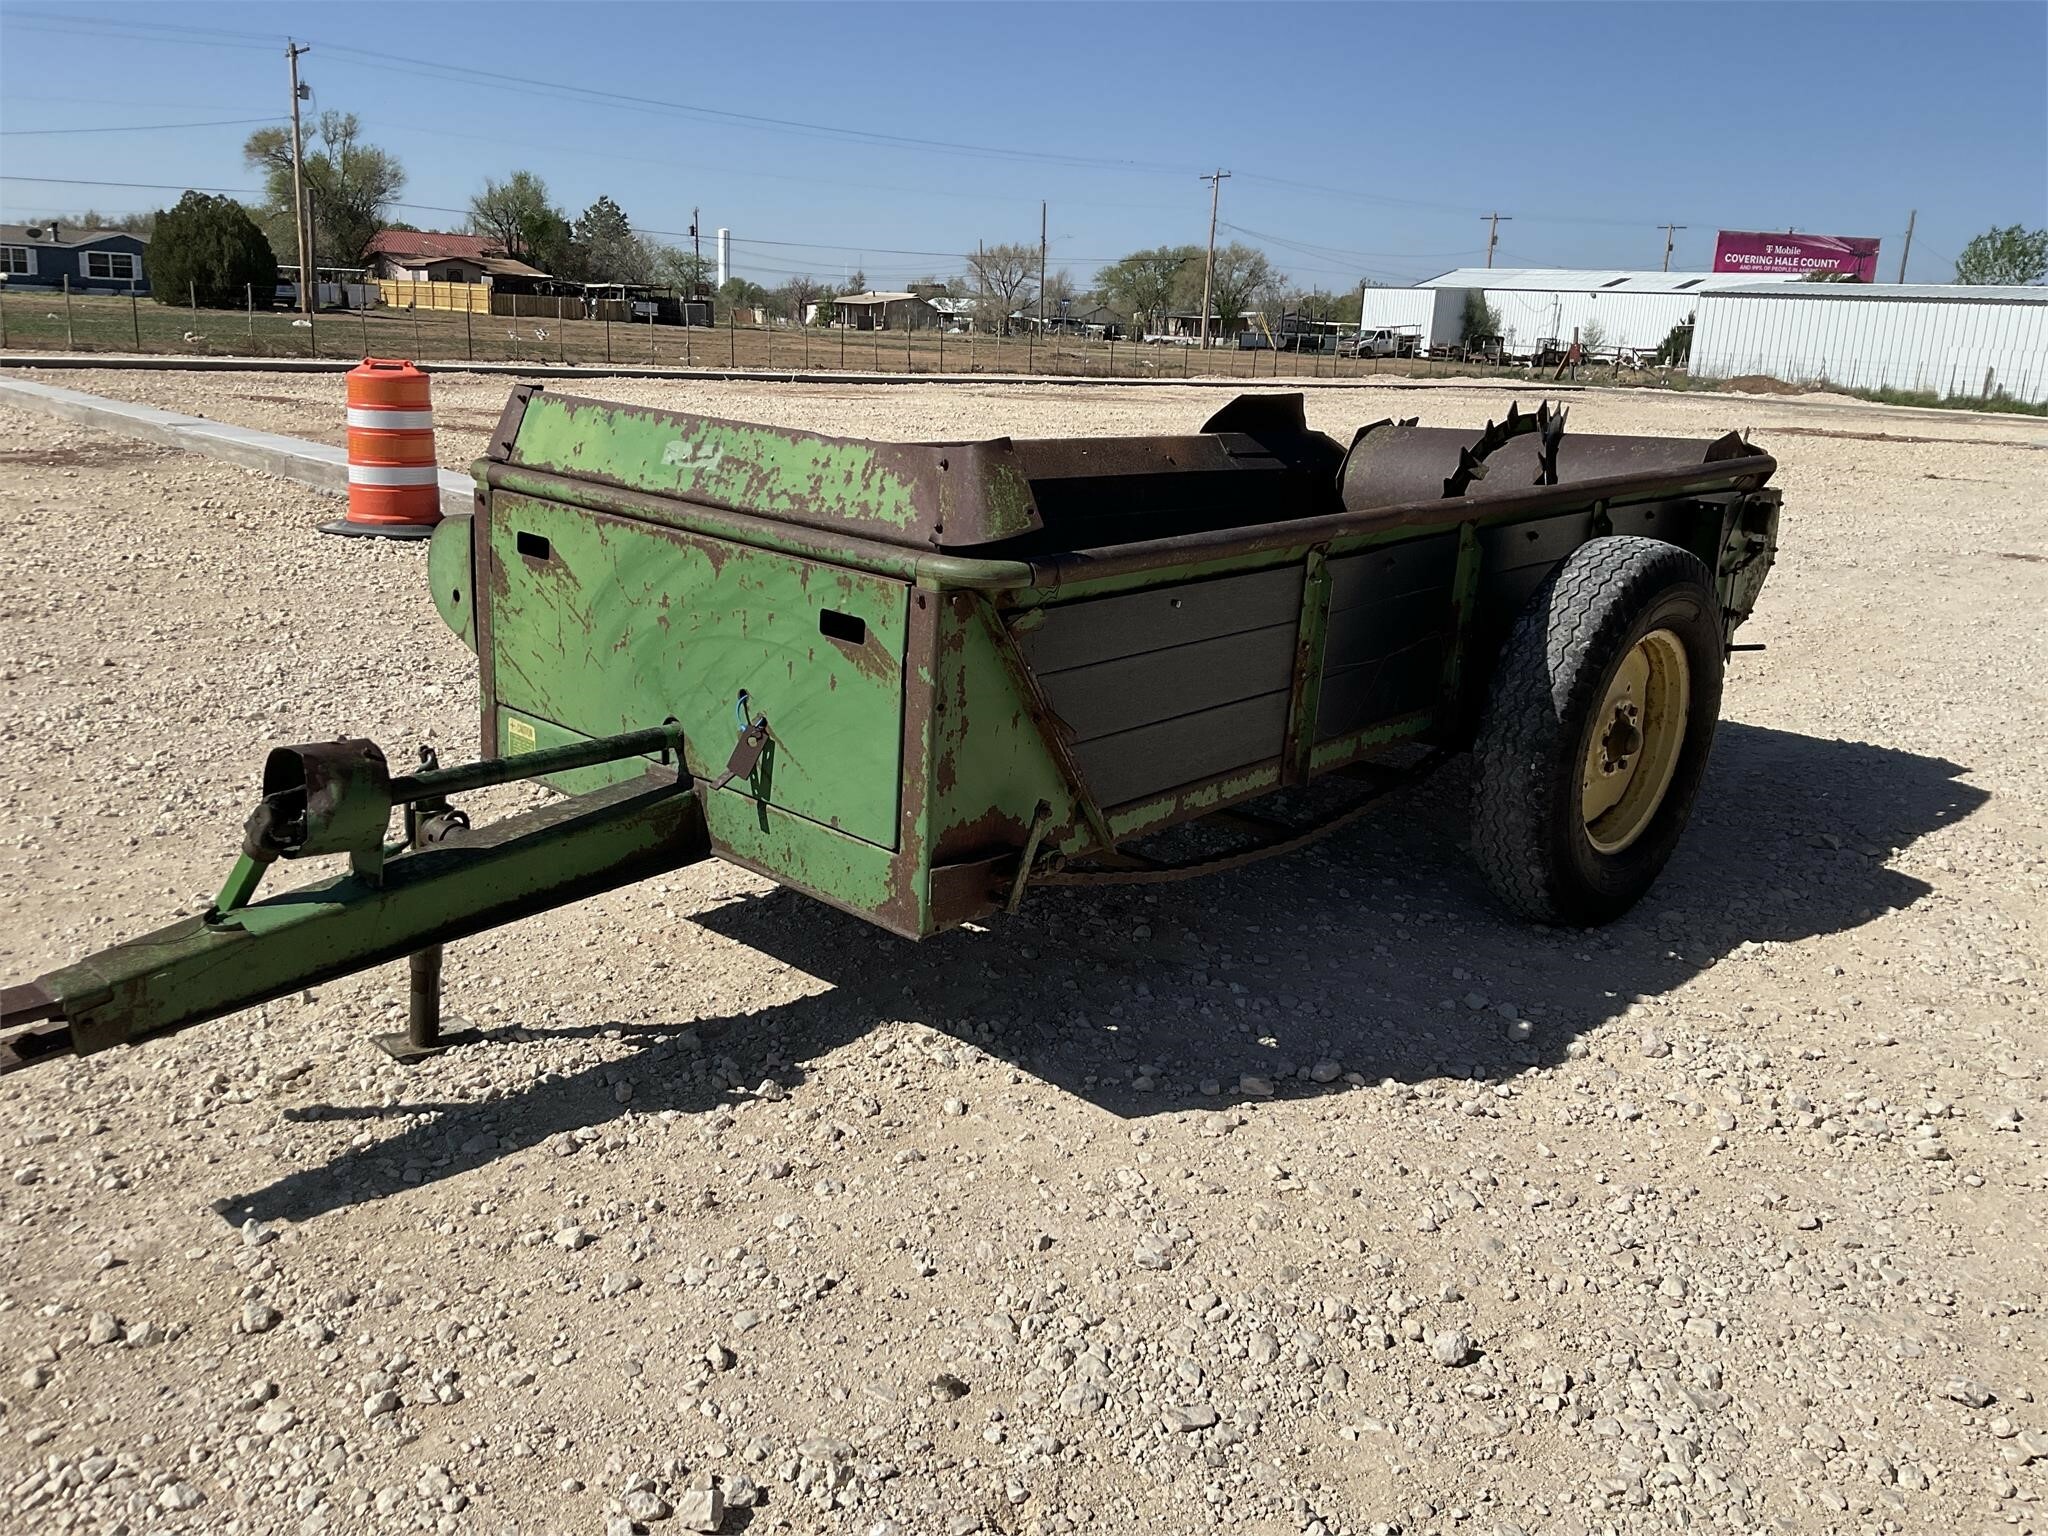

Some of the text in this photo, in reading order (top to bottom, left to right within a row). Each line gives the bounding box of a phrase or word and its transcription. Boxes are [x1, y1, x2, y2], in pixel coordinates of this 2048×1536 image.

[1774, 245, 1802, 255] Mobile
[1724, 253, 1841, 269] COVERING HALE COUNTY
